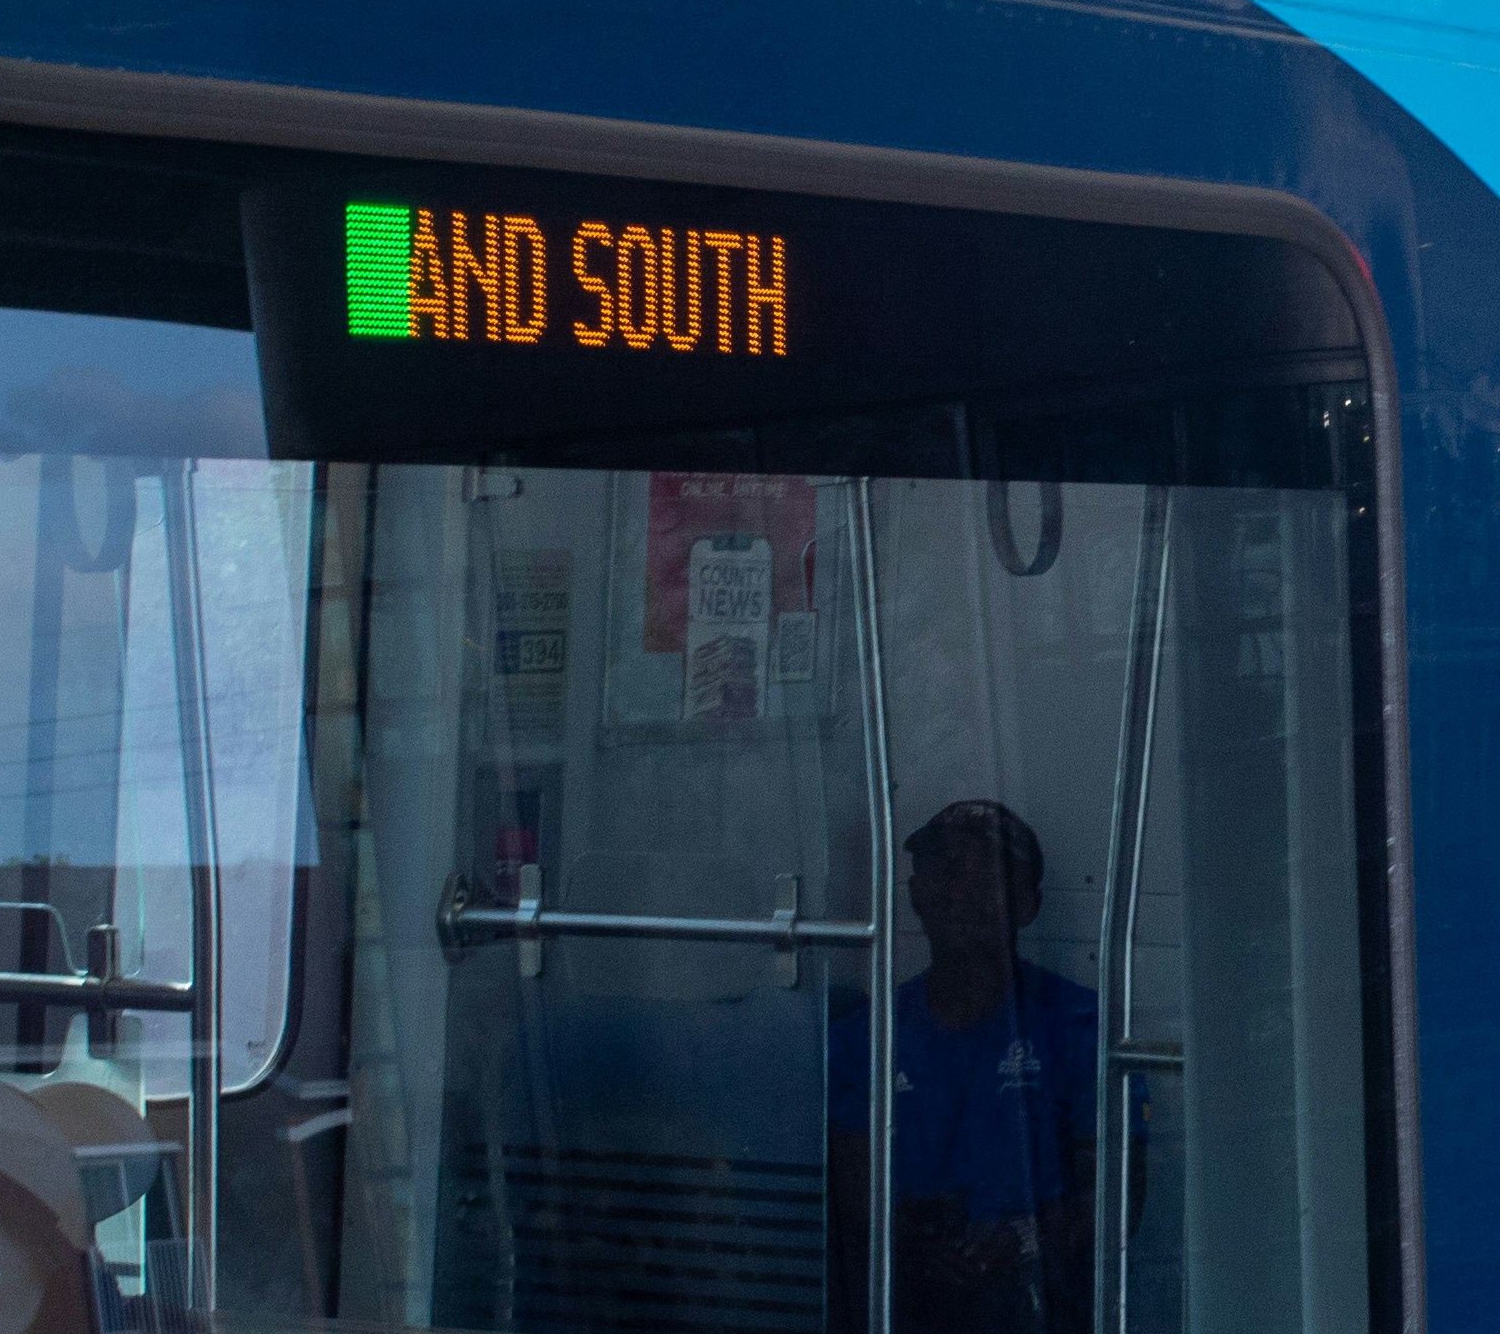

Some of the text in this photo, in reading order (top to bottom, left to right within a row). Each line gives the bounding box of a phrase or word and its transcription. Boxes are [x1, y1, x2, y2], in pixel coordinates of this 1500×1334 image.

[409, 209, 787, 356] AND SOUTH
[699, 589, 763, 616] NEWS
